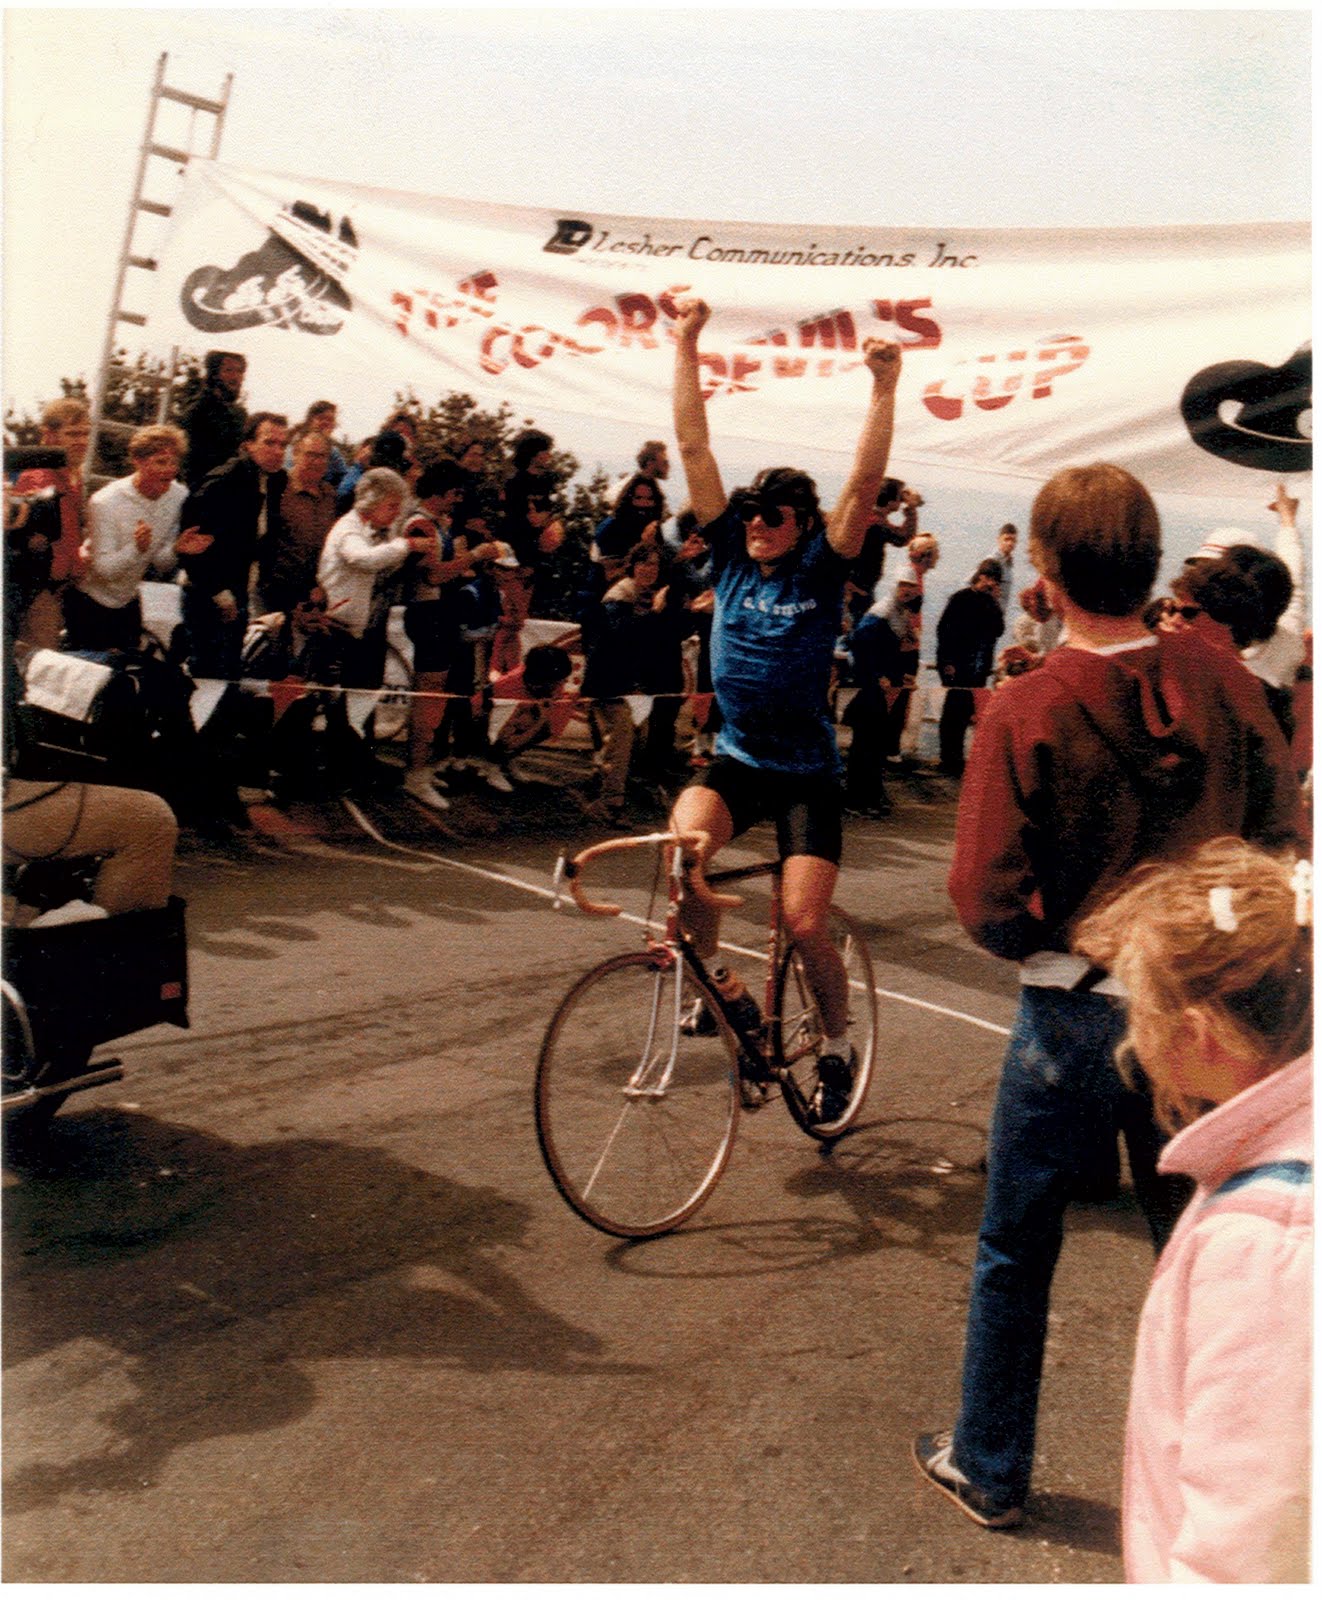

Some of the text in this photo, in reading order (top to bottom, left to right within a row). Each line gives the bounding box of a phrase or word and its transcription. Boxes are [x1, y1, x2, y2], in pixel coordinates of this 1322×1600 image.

[593, 231, 684, 257] Lesher
[687, 235, 915, 267] Communications
[921, 335, 1091, 421] CUP
